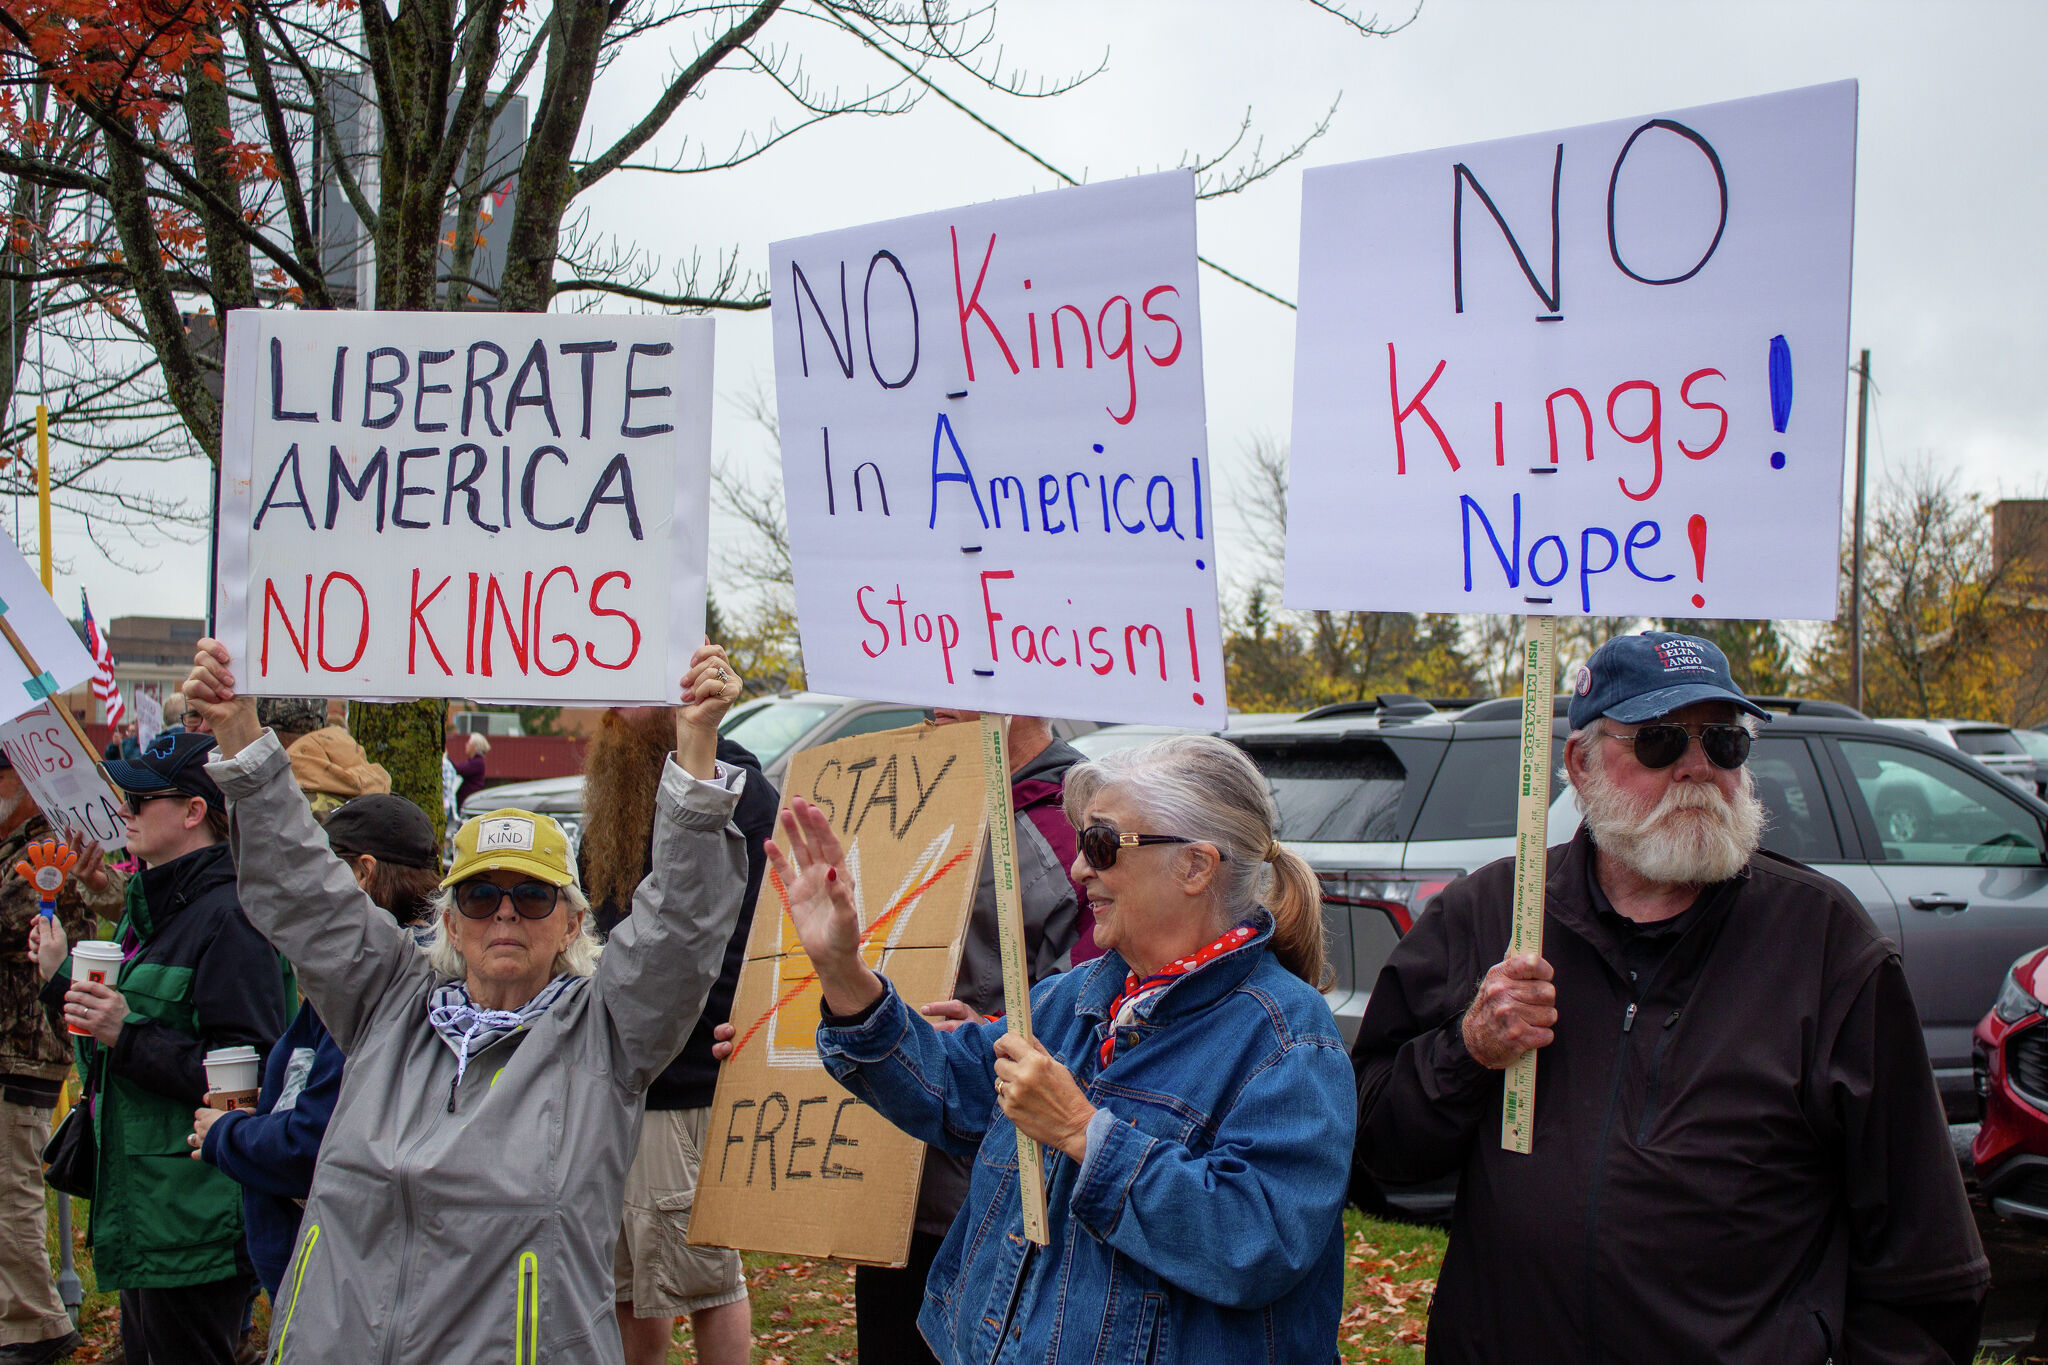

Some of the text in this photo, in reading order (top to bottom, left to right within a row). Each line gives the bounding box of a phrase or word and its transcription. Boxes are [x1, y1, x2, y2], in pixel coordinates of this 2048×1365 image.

[1453, 118, 1728, 314] NO
[792, 225, 1183, 425] NO Kings
[270, 337, 675, 440] LIBERATE
[253, 442, 644, 540] AMERICA
[821, 412, 1206, 570] In America!
[1459, 493, 1708, 613] Nope!
[262, 565, 642, 677] NO KINGS
[856, 569, 1205, 706] Stop Facism!
[1528, 640, 1538, 669] VISIT
[1657, 647, 1696, 660] DELTA
[1660, 656, 1703, 668] TANGO
[487, 832, 523, 845] KIND
[812, 754, 957, 841] STAY
[1003, 861, 1013, 890] VISIT
[1518, 832, 1527, 872] Dedicated
[1518, 874, 1526, 883] to
[1514, 923, 1523, 951] Quality
[1516, 884, 1525, 914] Service
[719, 1090, 870, 1191] FREE
